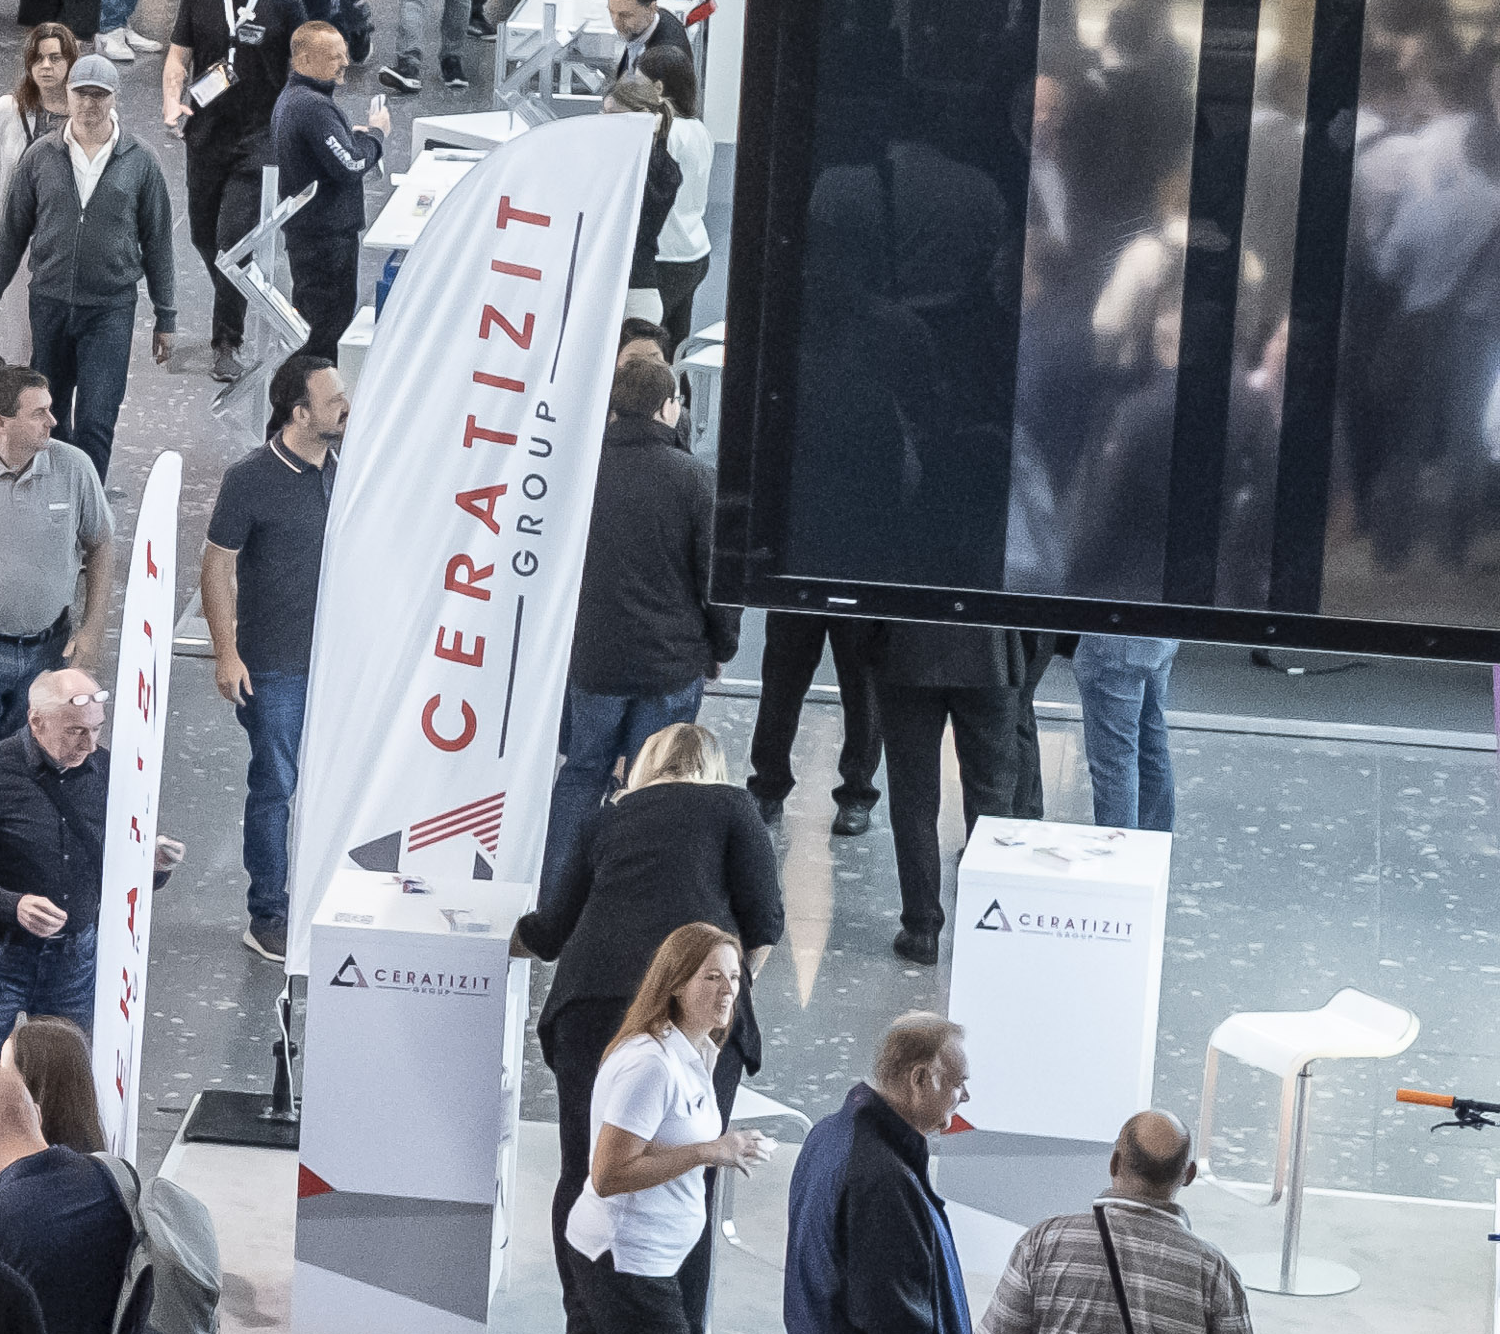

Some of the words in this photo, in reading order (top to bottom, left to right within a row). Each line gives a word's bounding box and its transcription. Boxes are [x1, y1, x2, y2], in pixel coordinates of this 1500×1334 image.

[421, 195, 552, 752] CERATIZIT
[512, 400, 558, 578] GROUP
[1018, 912, 1133, 935] CERATIZIT
[374, 968, 491, 990] CERATIZIT
